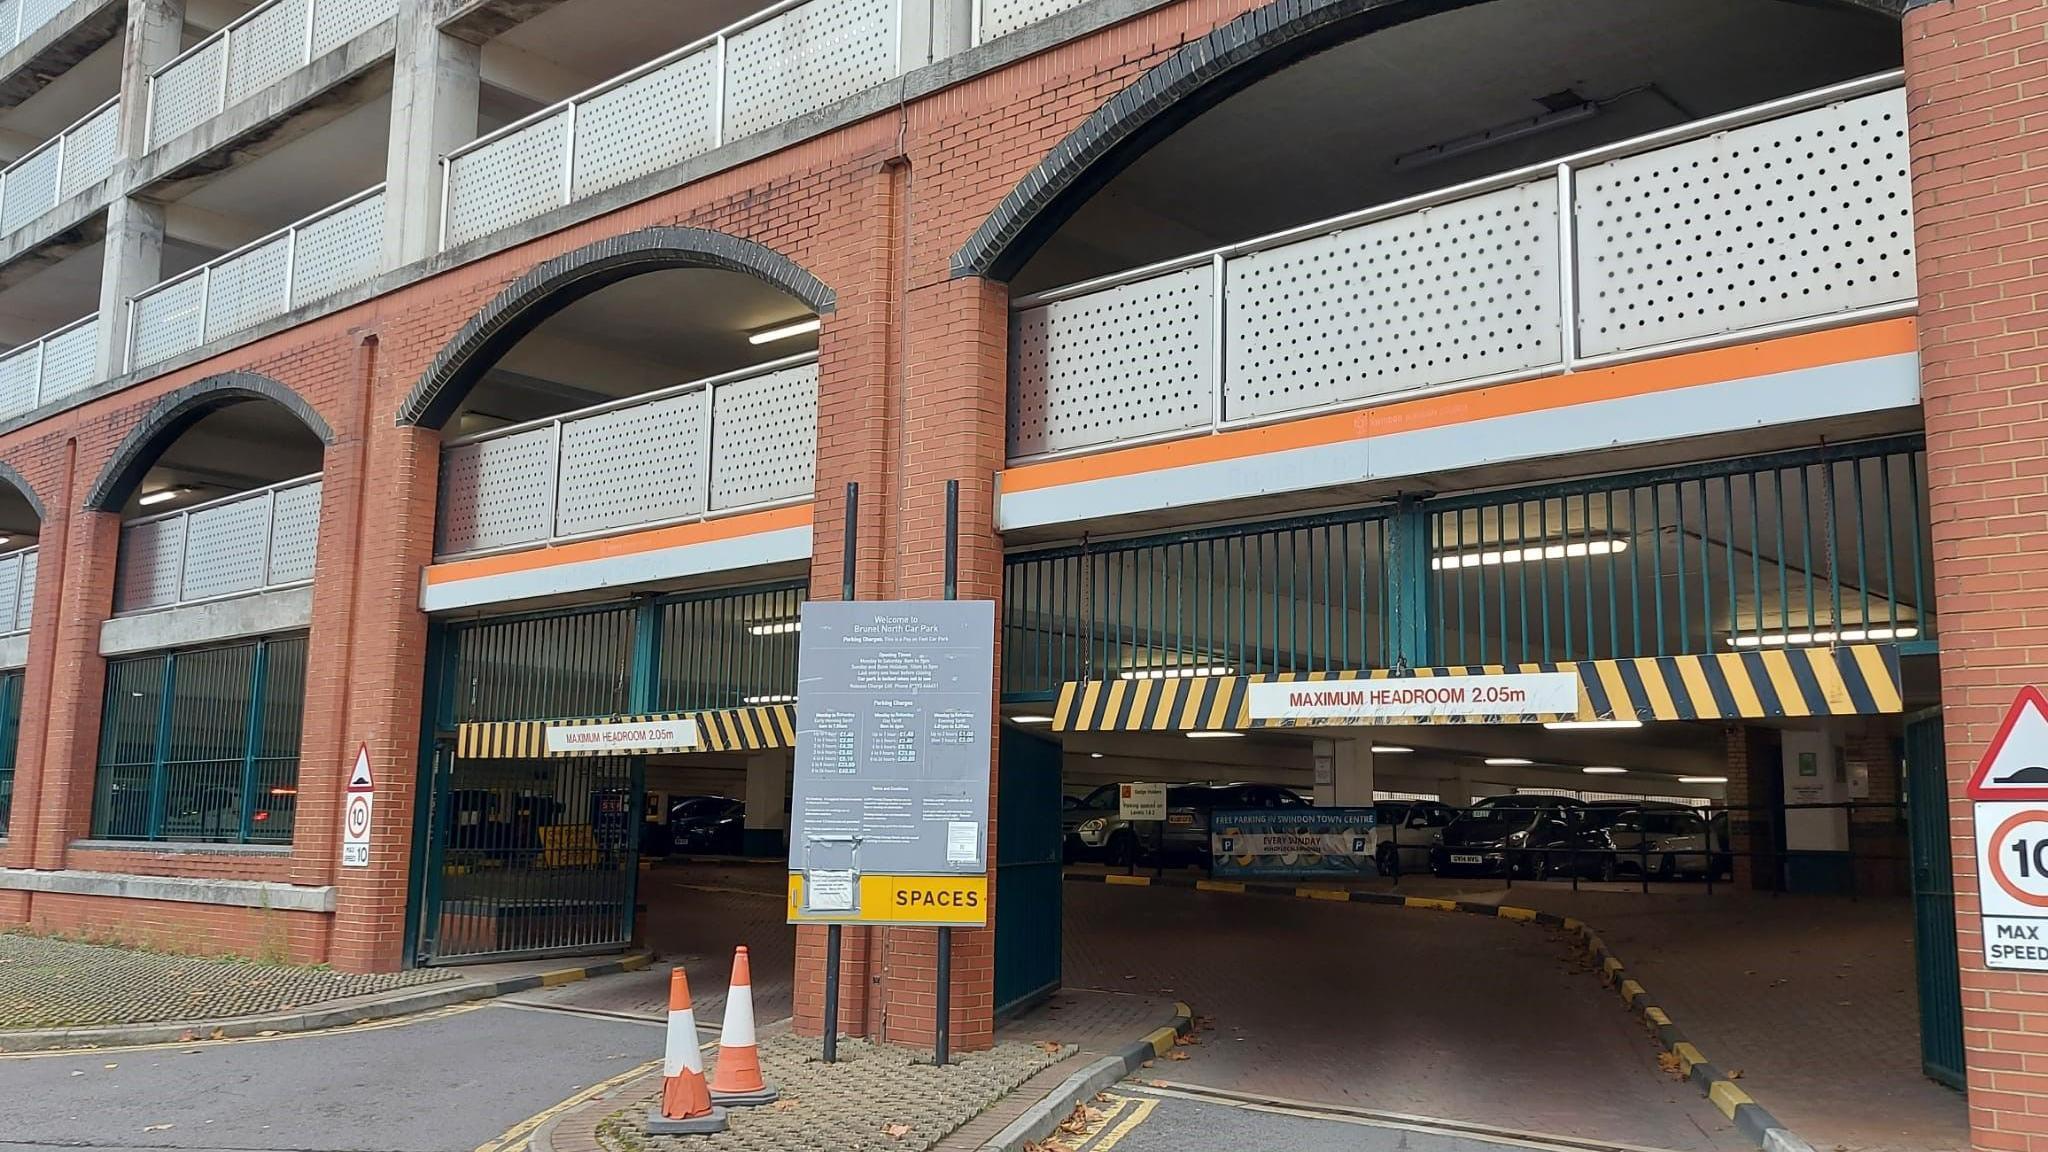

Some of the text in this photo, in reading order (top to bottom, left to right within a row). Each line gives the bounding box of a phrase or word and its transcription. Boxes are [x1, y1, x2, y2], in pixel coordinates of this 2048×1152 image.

[874, 615, 918, 624] Welcome to
[854, 624, 939, 633] Brunel North Car Park
[1289, 686, 1526, 707] MAXIMUM HEADROOM 2.05m
[566, 729, 674, 744] MAXIMUM HEADROOM 2.05m
[352, 808, 364, 826] 10
[1215, 816, 1233, 825] FREE
[1234, 815, 1267, 824] PARKING
[1277, 815, 1316, 823] SWINDON
[1316, 815, 1343, 823] TOWN
[1343, 814, 1375, 823] CENTRE
[1263, 837, 1321, 846] EVERY SUNDAY
[357, 846, 368, 863] 10
[896, 890, 978, 907] SPACES
[1997, 924, 2039, 940] MAX
[1991, 945, 2048, 961] SPEED
